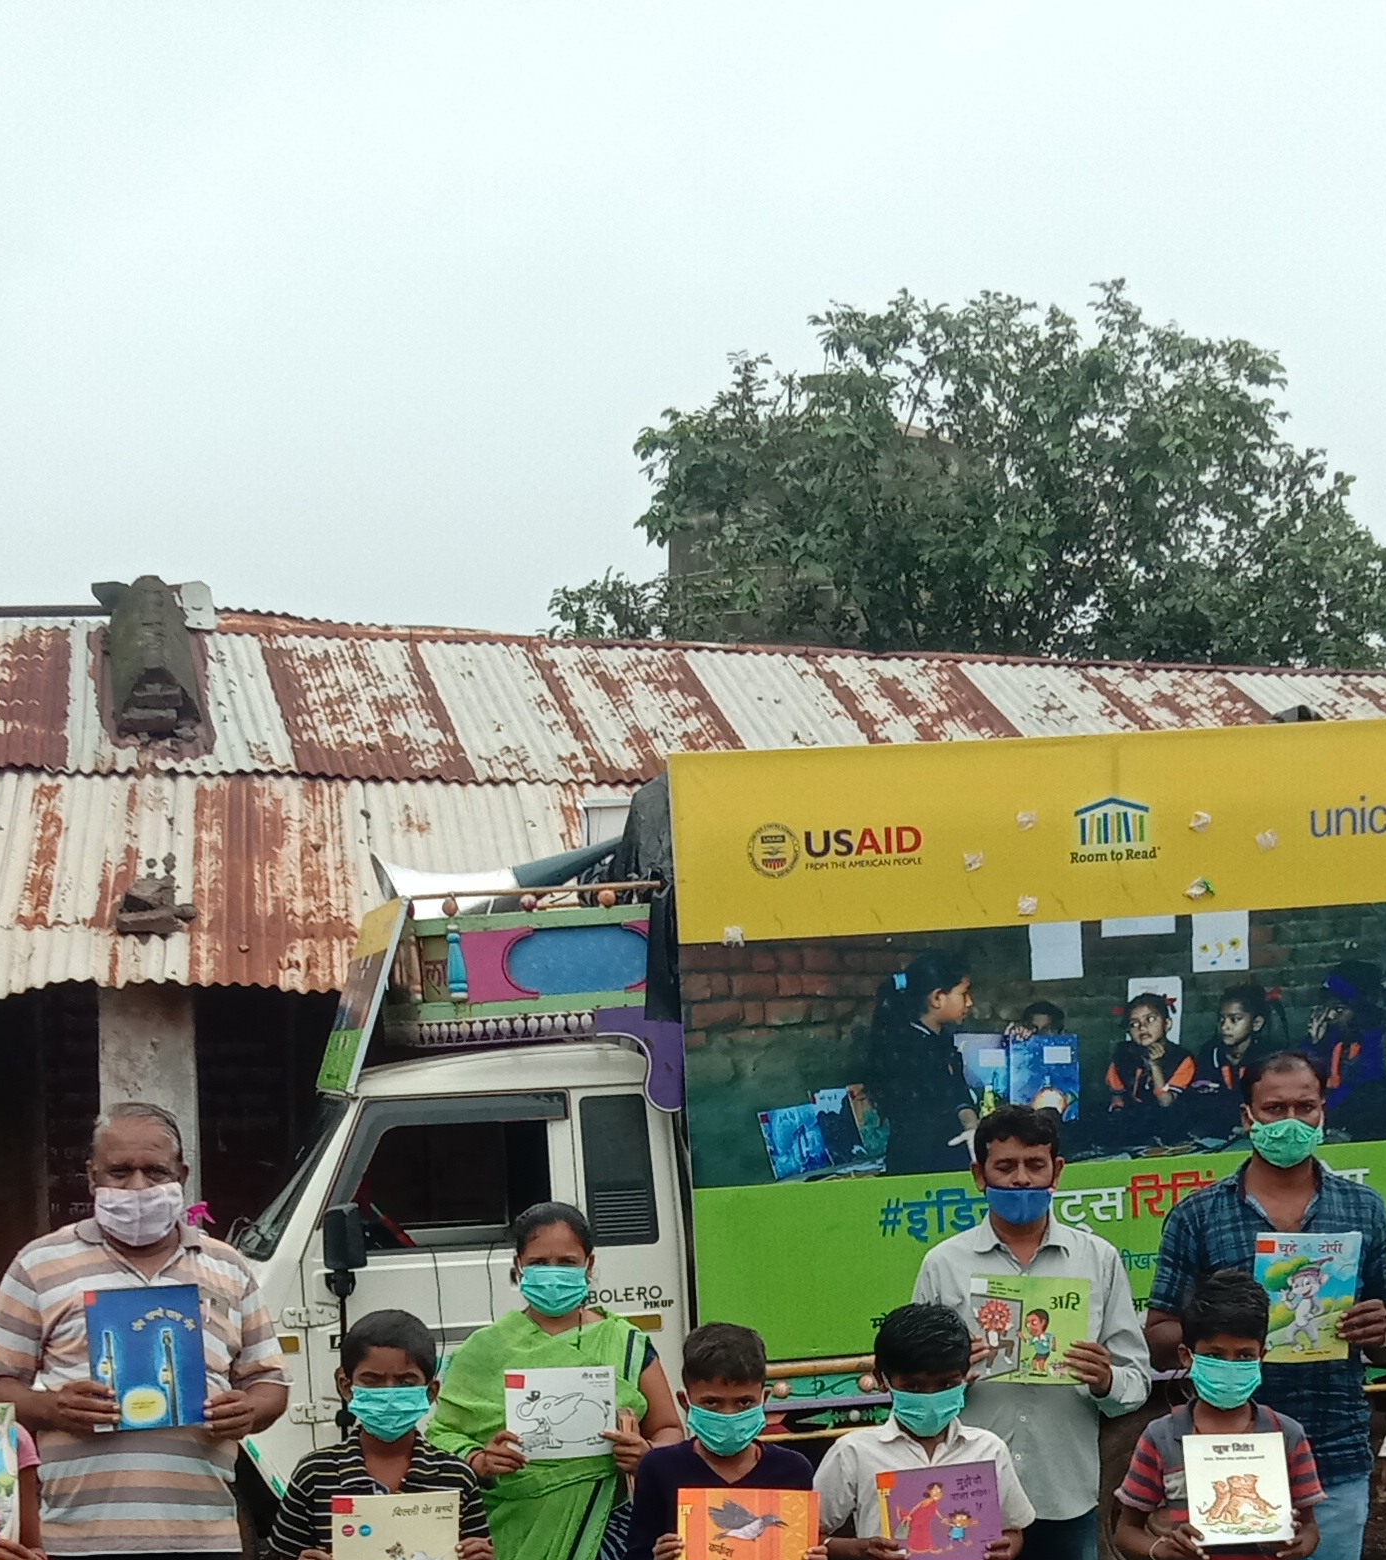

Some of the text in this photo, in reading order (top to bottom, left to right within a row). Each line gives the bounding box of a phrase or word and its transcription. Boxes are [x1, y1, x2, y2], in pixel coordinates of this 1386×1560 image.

[804, 825, 922, 858] USAID
[805, 857, 922, 871] FROM THE AMERICAN PEOPLE
[1070, 847, 1157, 865] Room to Read
[1318, 1240, 1343, 1254] टोपी
[588, 1285, 663, 1305] BOLERO
